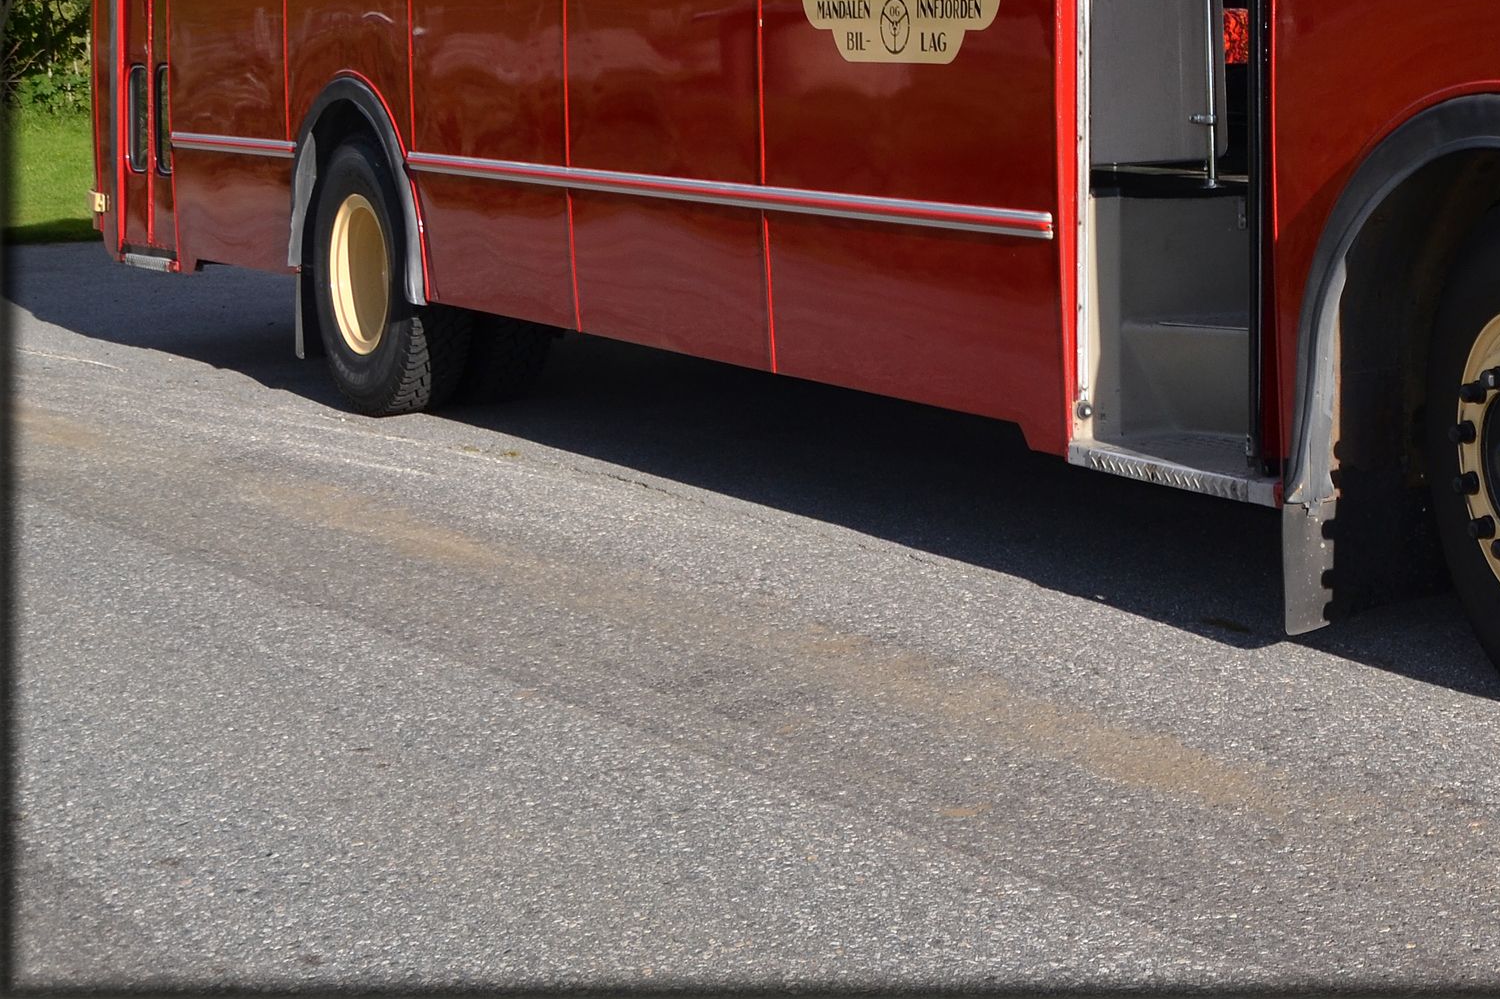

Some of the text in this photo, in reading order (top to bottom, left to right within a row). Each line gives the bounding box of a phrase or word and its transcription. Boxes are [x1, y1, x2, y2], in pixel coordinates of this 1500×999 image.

[889, 6, 901, 17] OG
[846, 31, 947, 52] BIL- LAG
